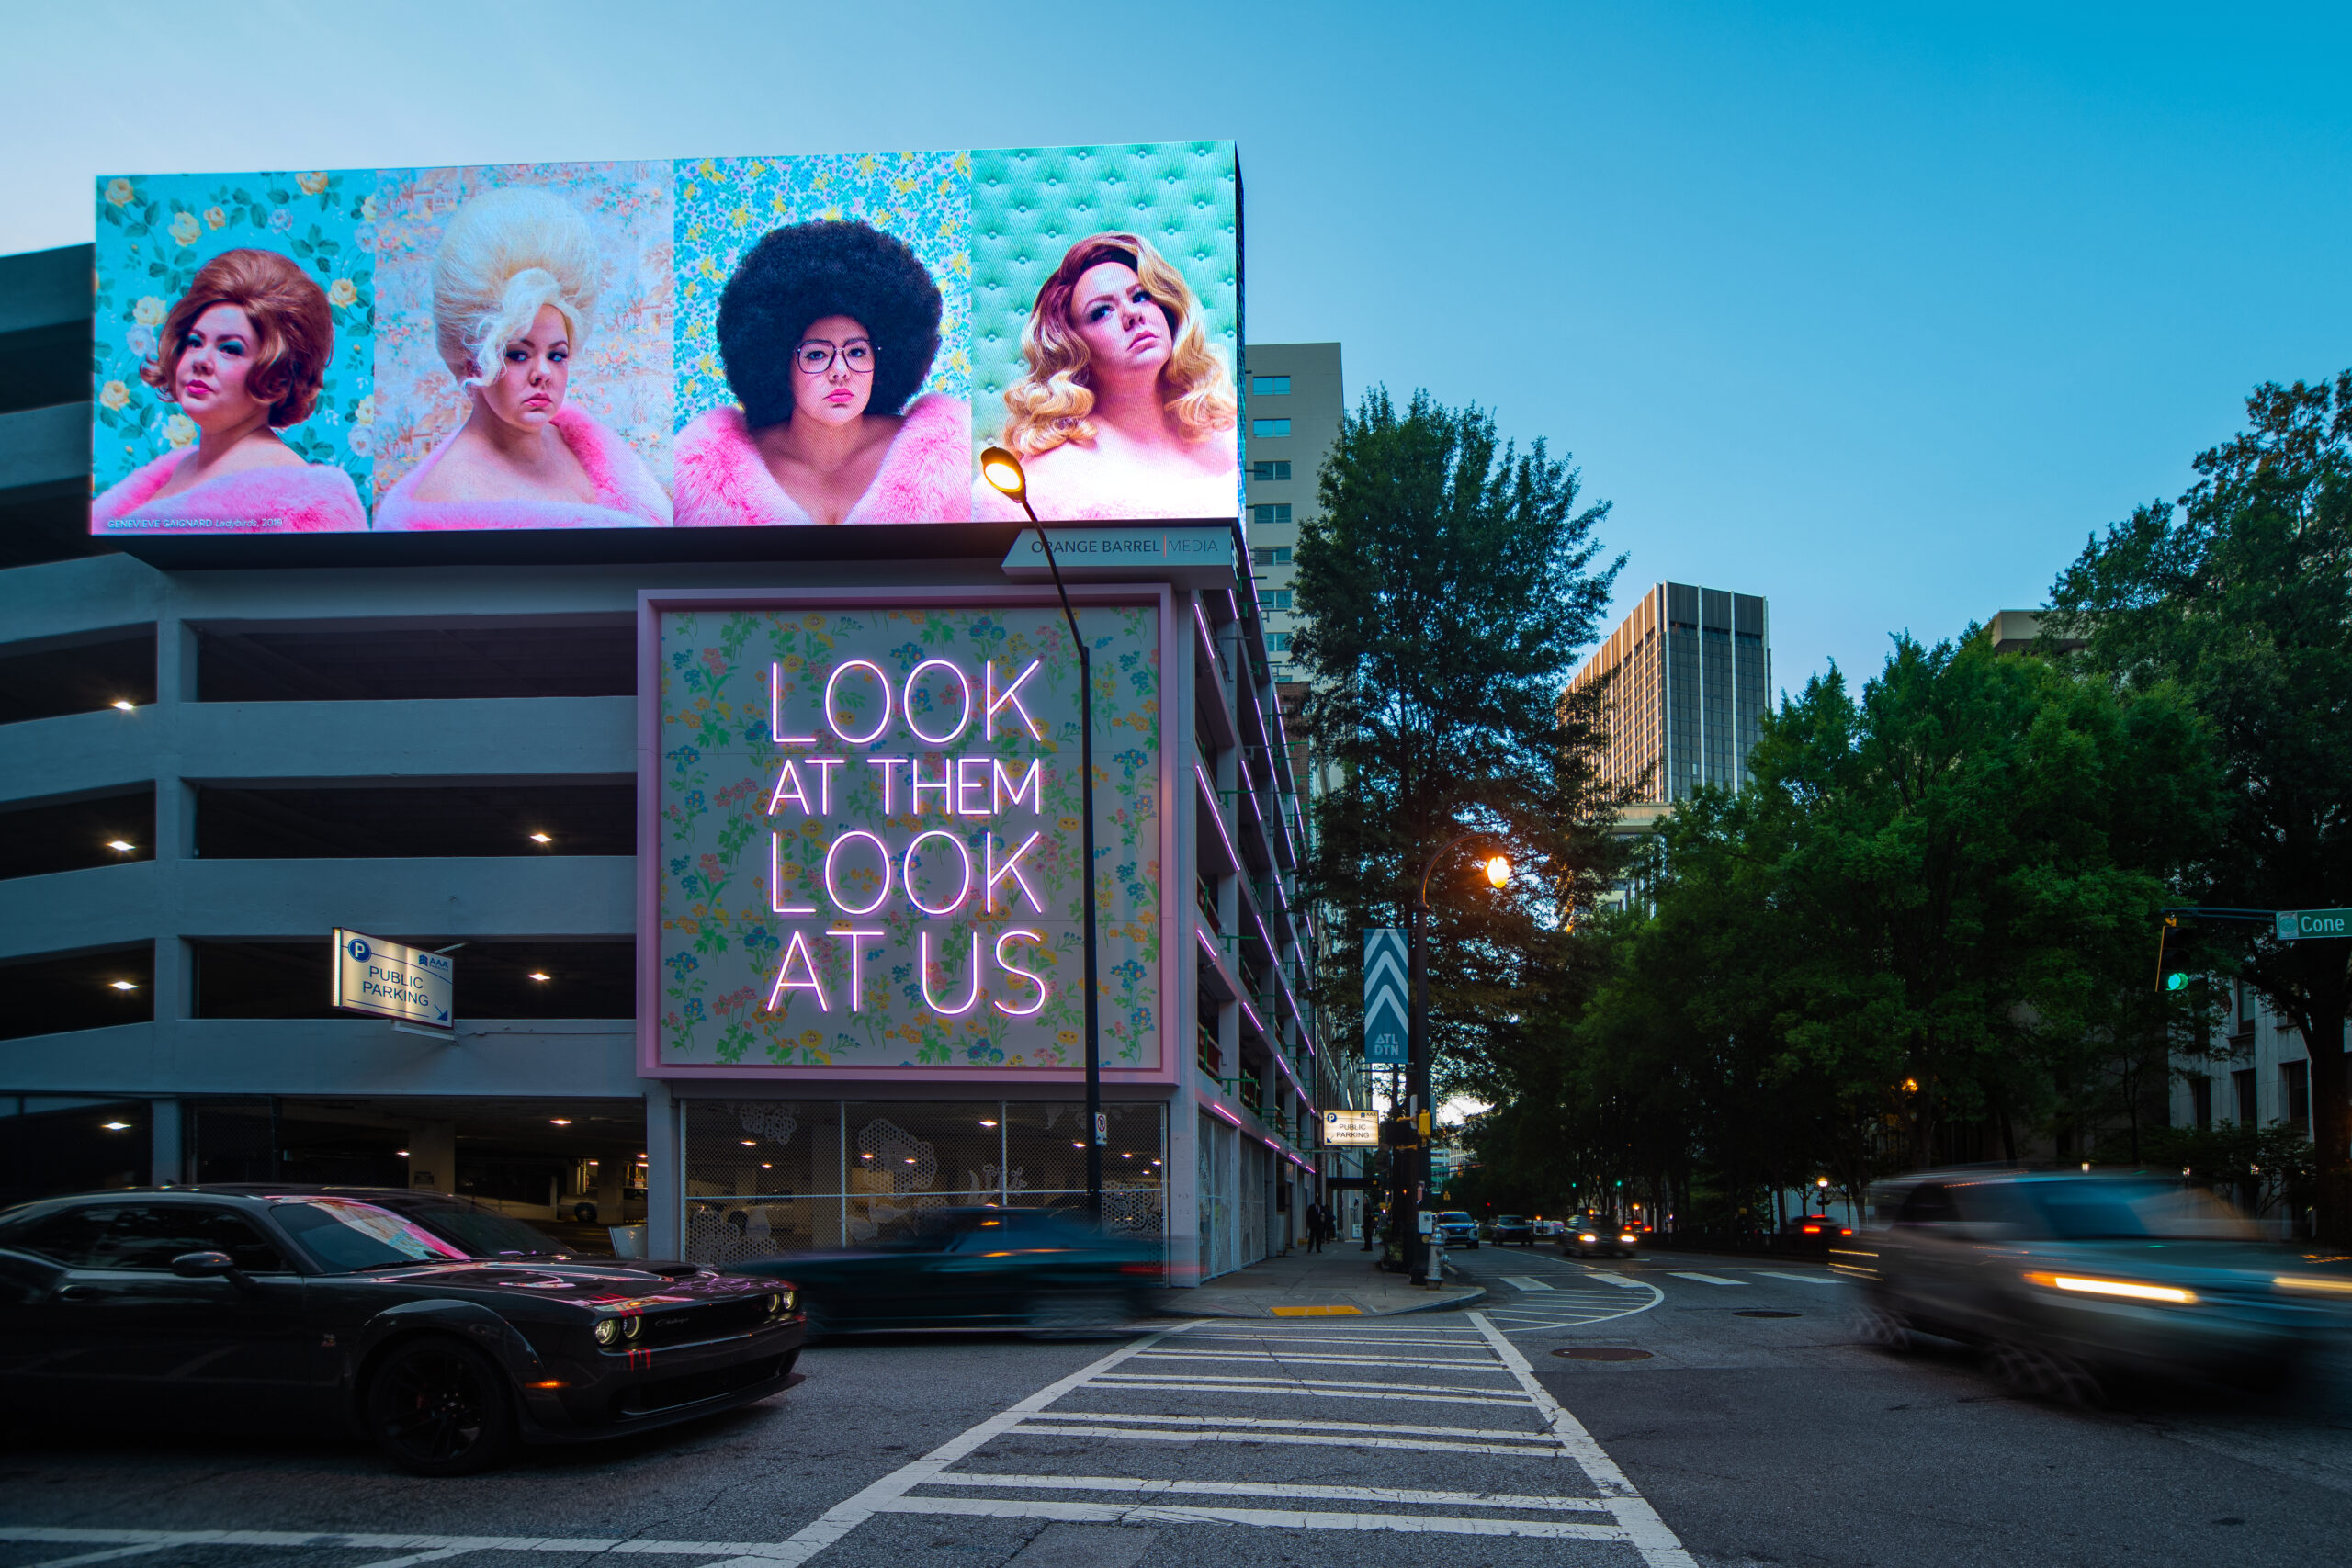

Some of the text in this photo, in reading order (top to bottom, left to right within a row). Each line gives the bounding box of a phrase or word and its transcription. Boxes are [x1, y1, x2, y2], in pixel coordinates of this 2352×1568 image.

[107, 517, 283, 529] GENEVIEVE GAIGNARD Ladybirds, 2019
[1102, 540, 1160, 553] BARREL
[1169, 539, 1218, 552] MEDIA
[772, 659, 1042, 744] LOOK
[768, 758, 1041, 816] AT THEM
[772, 830, 1042, 914] LOOK
[2301, 915, 2345, 933] Cone
[355, 942, 366, 958] P
[429, 956, 449, 969] AAA
[369, 965, 424, 989] PUBLIC
[767, 930, 1046, 1015] AT US
[362, 981, 429, 1006] PARKING
[1374, 1033, 1398, 1044] ATL
[1374, 1044, 1399, 1055] DTN
